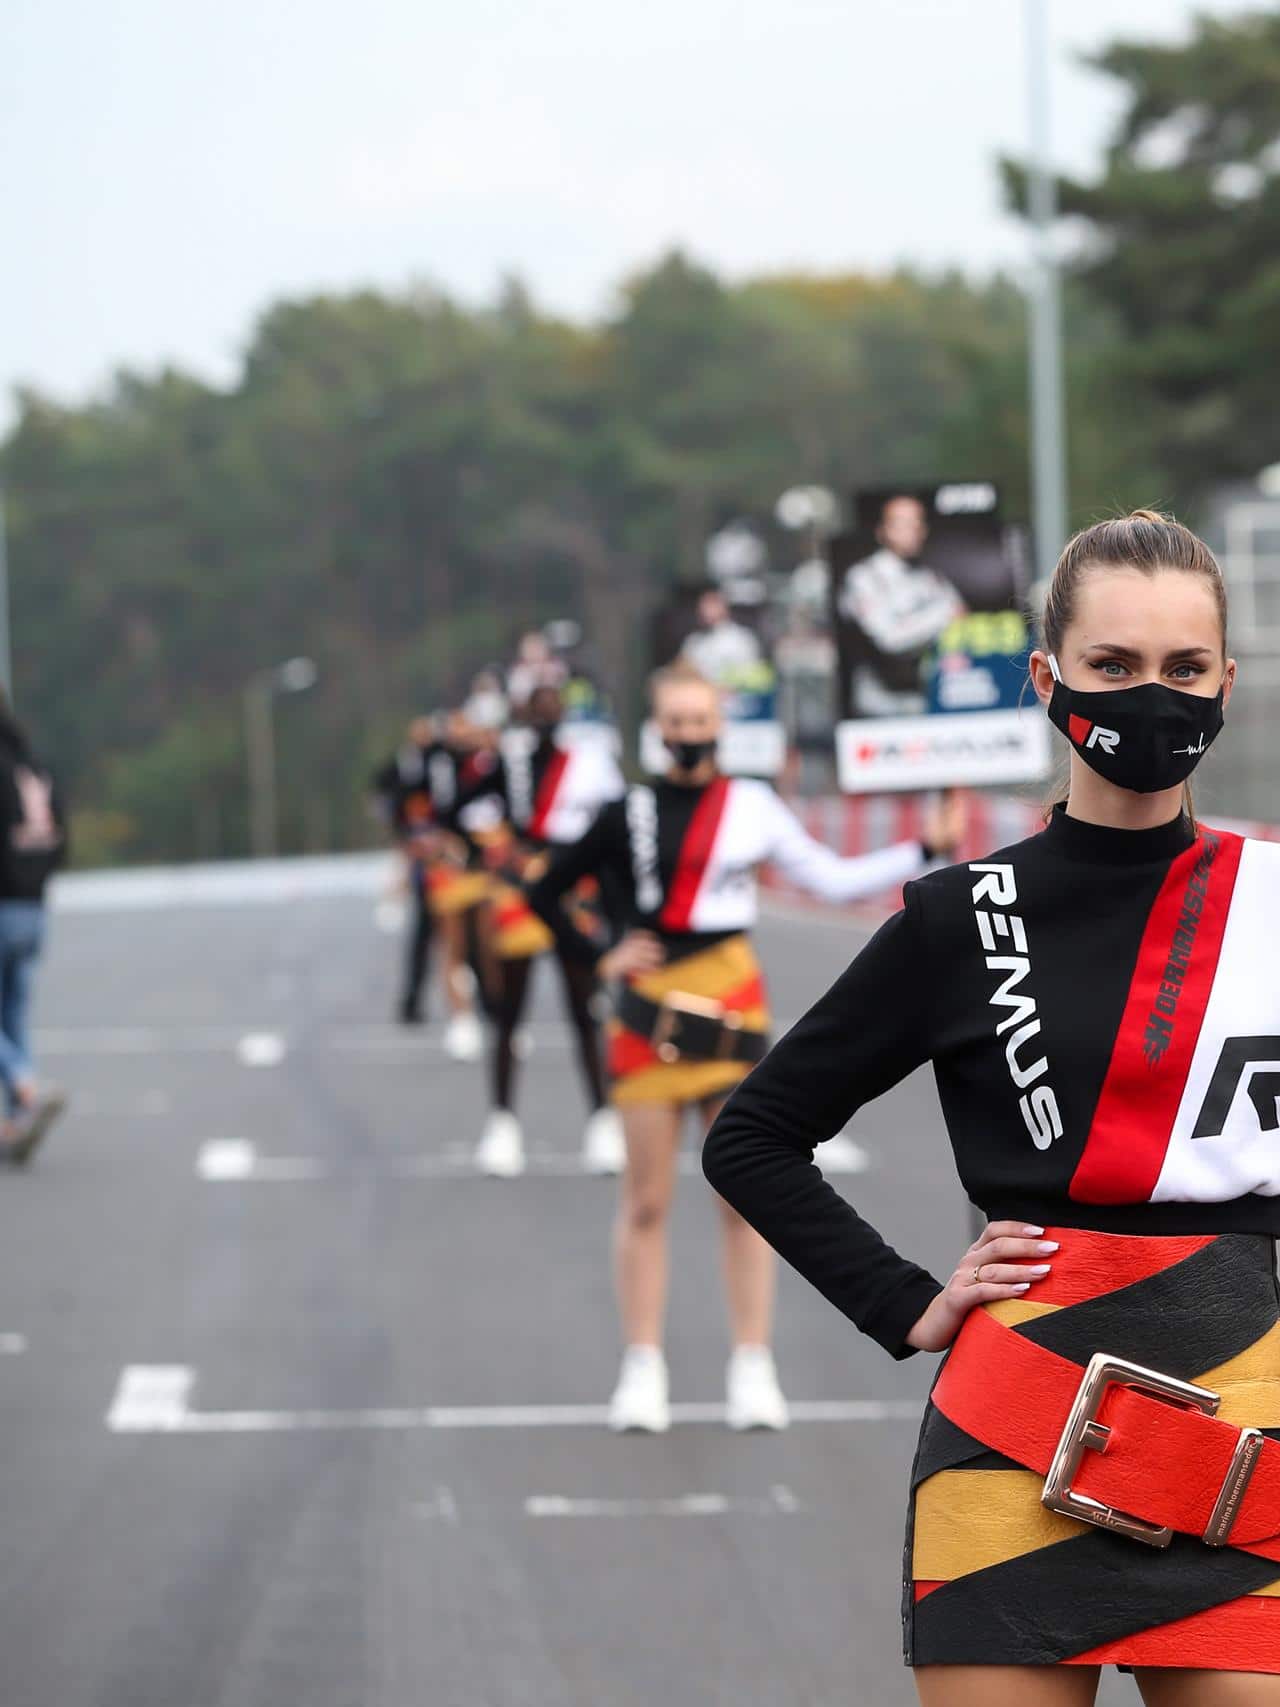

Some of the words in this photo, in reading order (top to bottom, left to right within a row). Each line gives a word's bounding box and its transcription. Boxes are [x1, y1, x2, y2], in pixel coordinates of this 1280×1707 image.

[1086, 725, 1121, 755] R
[969, 863, 1063, 1151] REMUS
[1217, 1507, 1233, 1536] marina
